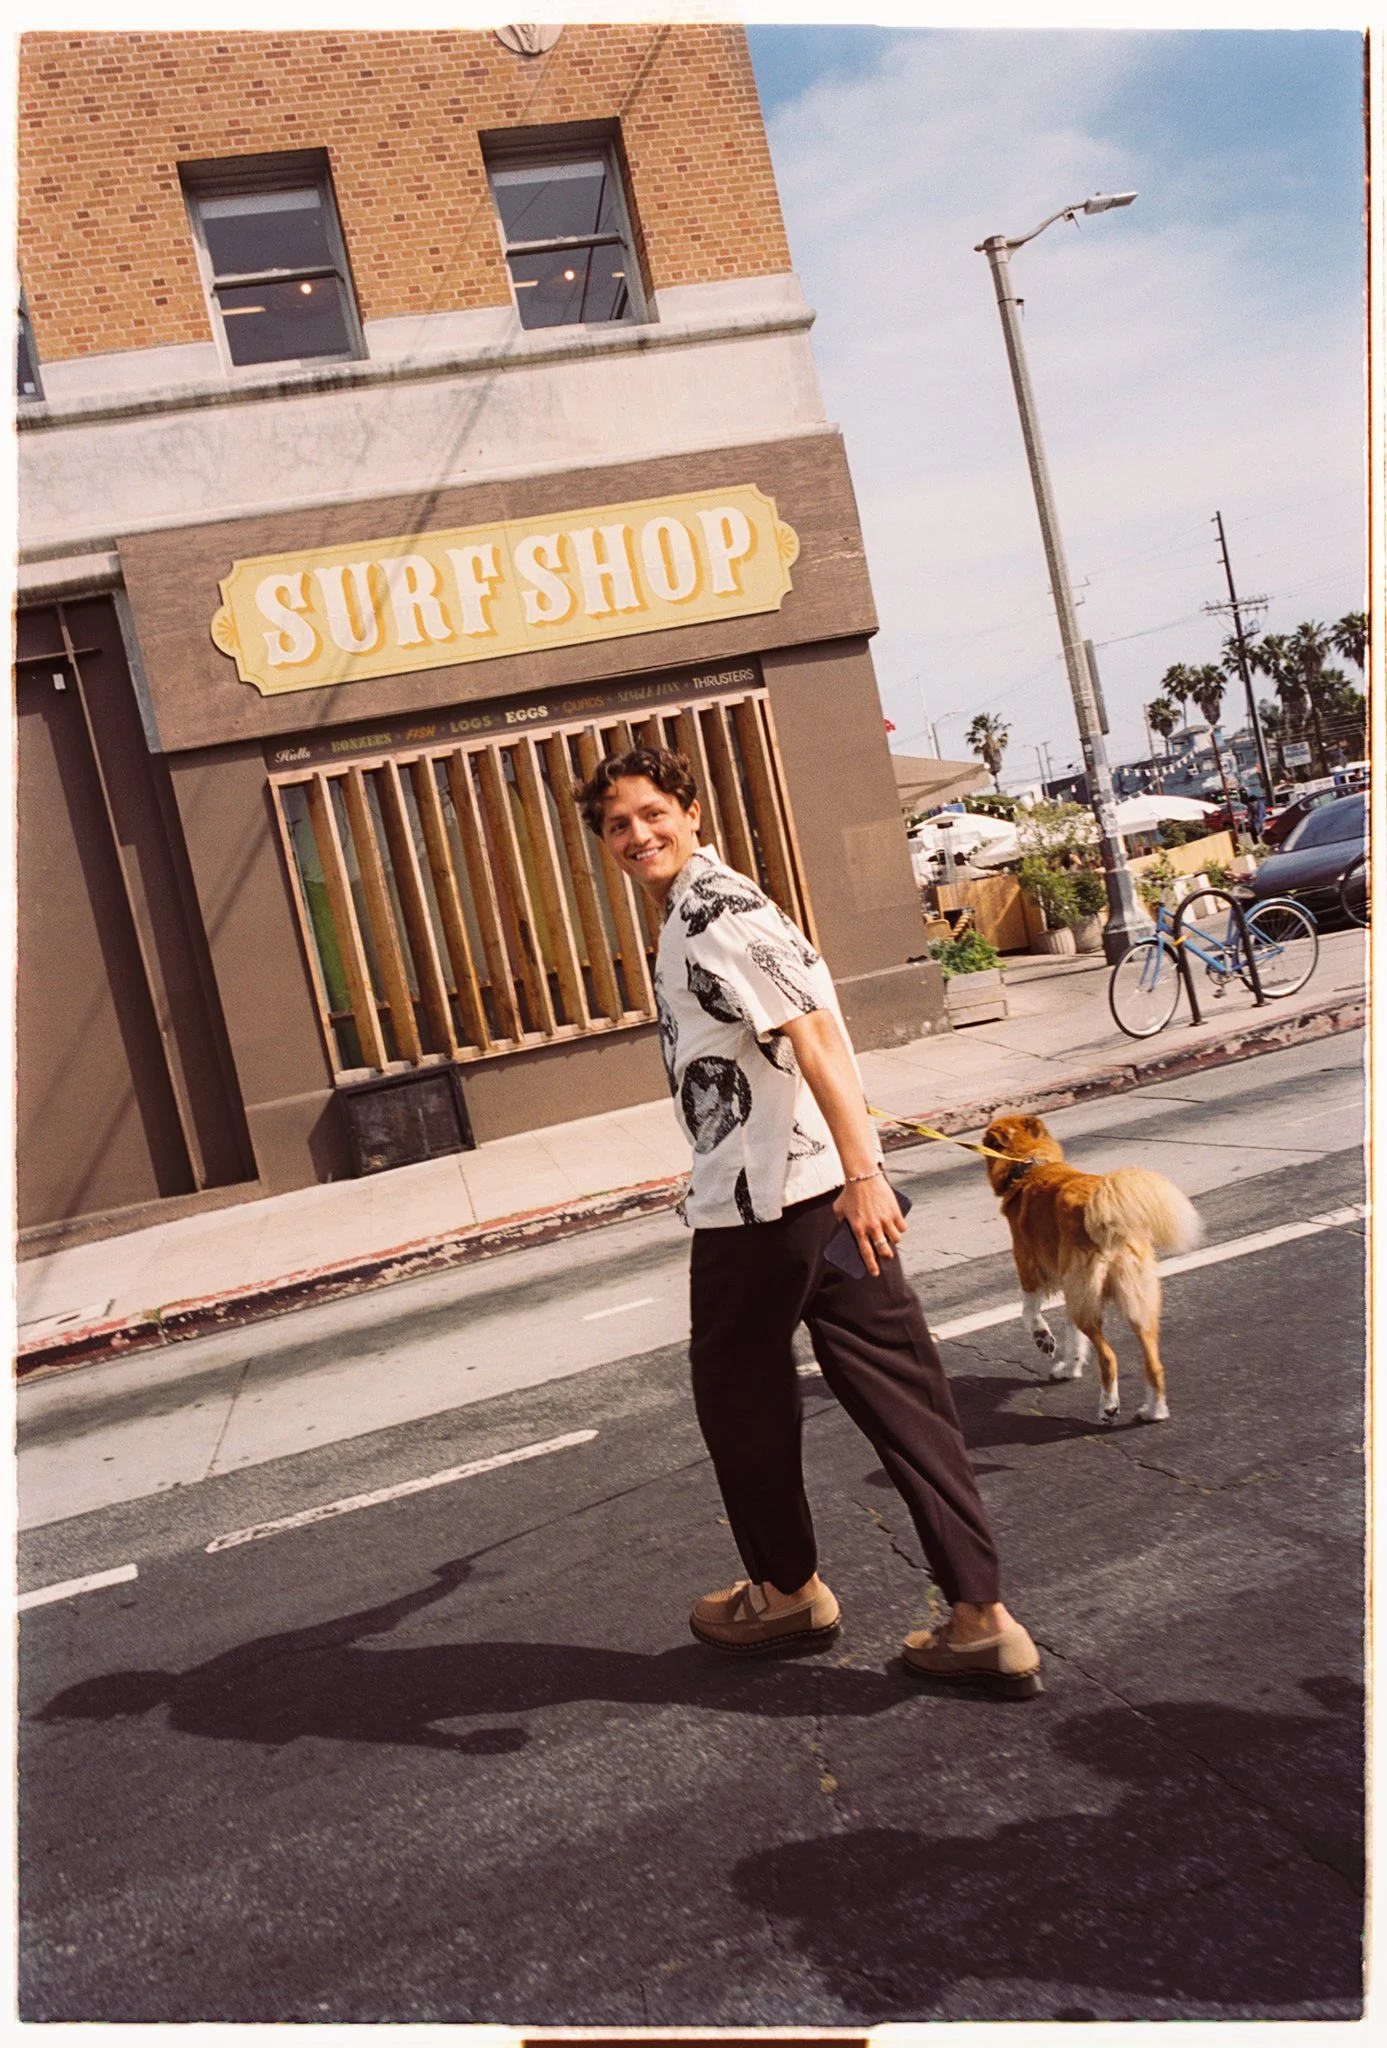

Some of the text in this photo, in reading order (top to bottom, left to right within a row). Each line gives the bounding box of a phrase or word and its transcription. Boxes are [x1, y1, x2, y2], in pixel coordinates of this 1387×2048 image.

[255, 505, 759, 667] SURF SHOP
[406, 725, 436, 741] FISH
[450, 715, 492, 733] LOGS
[504, 705, 549, 724] EGGS
[562, 695, 604, 714] QUADS
[692, 669, 754, 689] THRUSTERS
